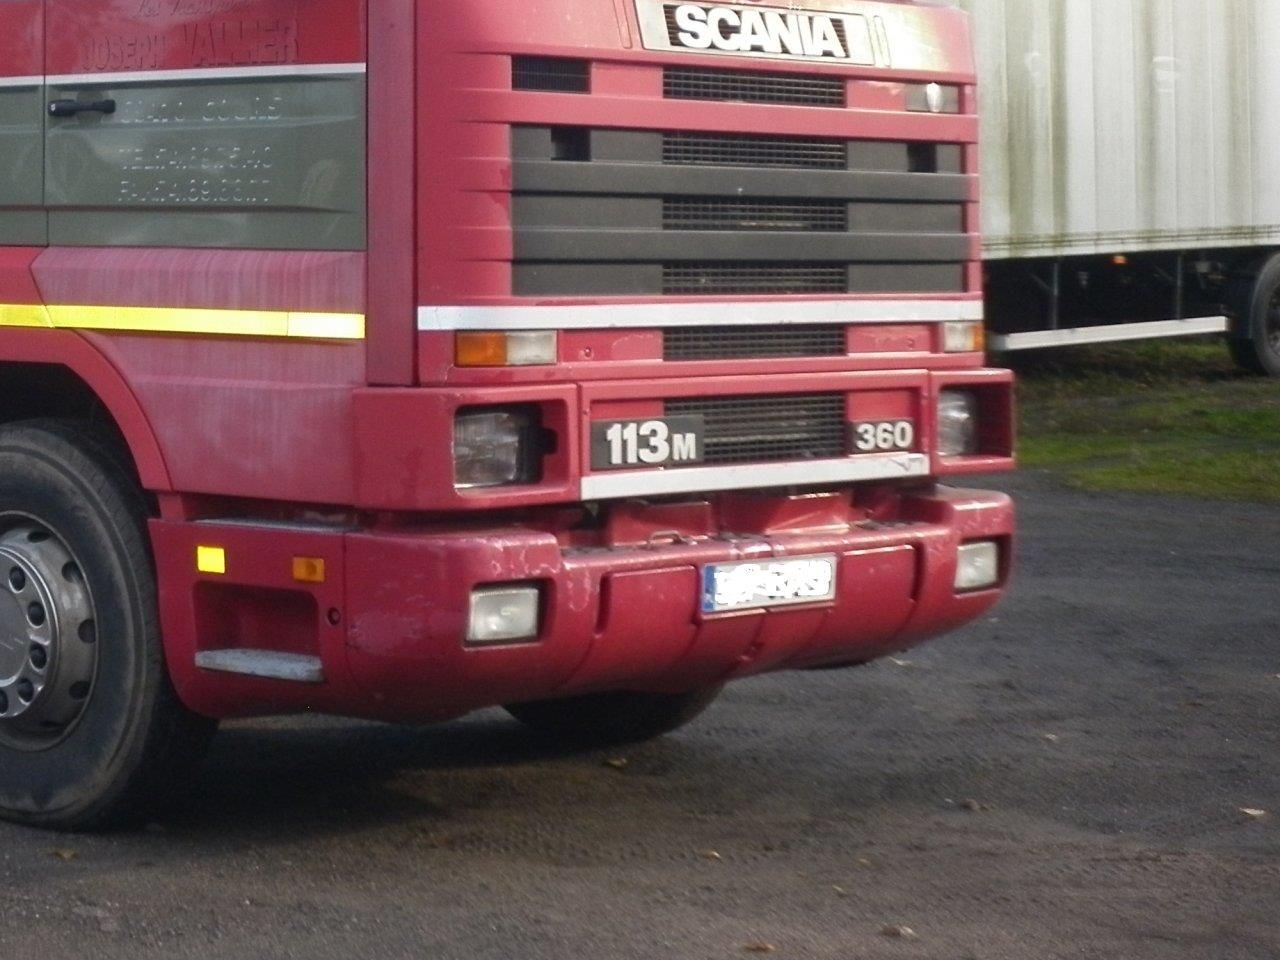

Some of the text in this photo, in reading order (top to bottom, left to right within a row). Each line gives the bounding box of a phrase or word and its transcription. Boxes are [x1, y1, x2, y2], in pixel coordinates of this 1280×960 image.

[182, 19, 301, 68] VALLIER
[674, 4, 846, 58] SCANIA
[856, 421, 914, 451] 360
